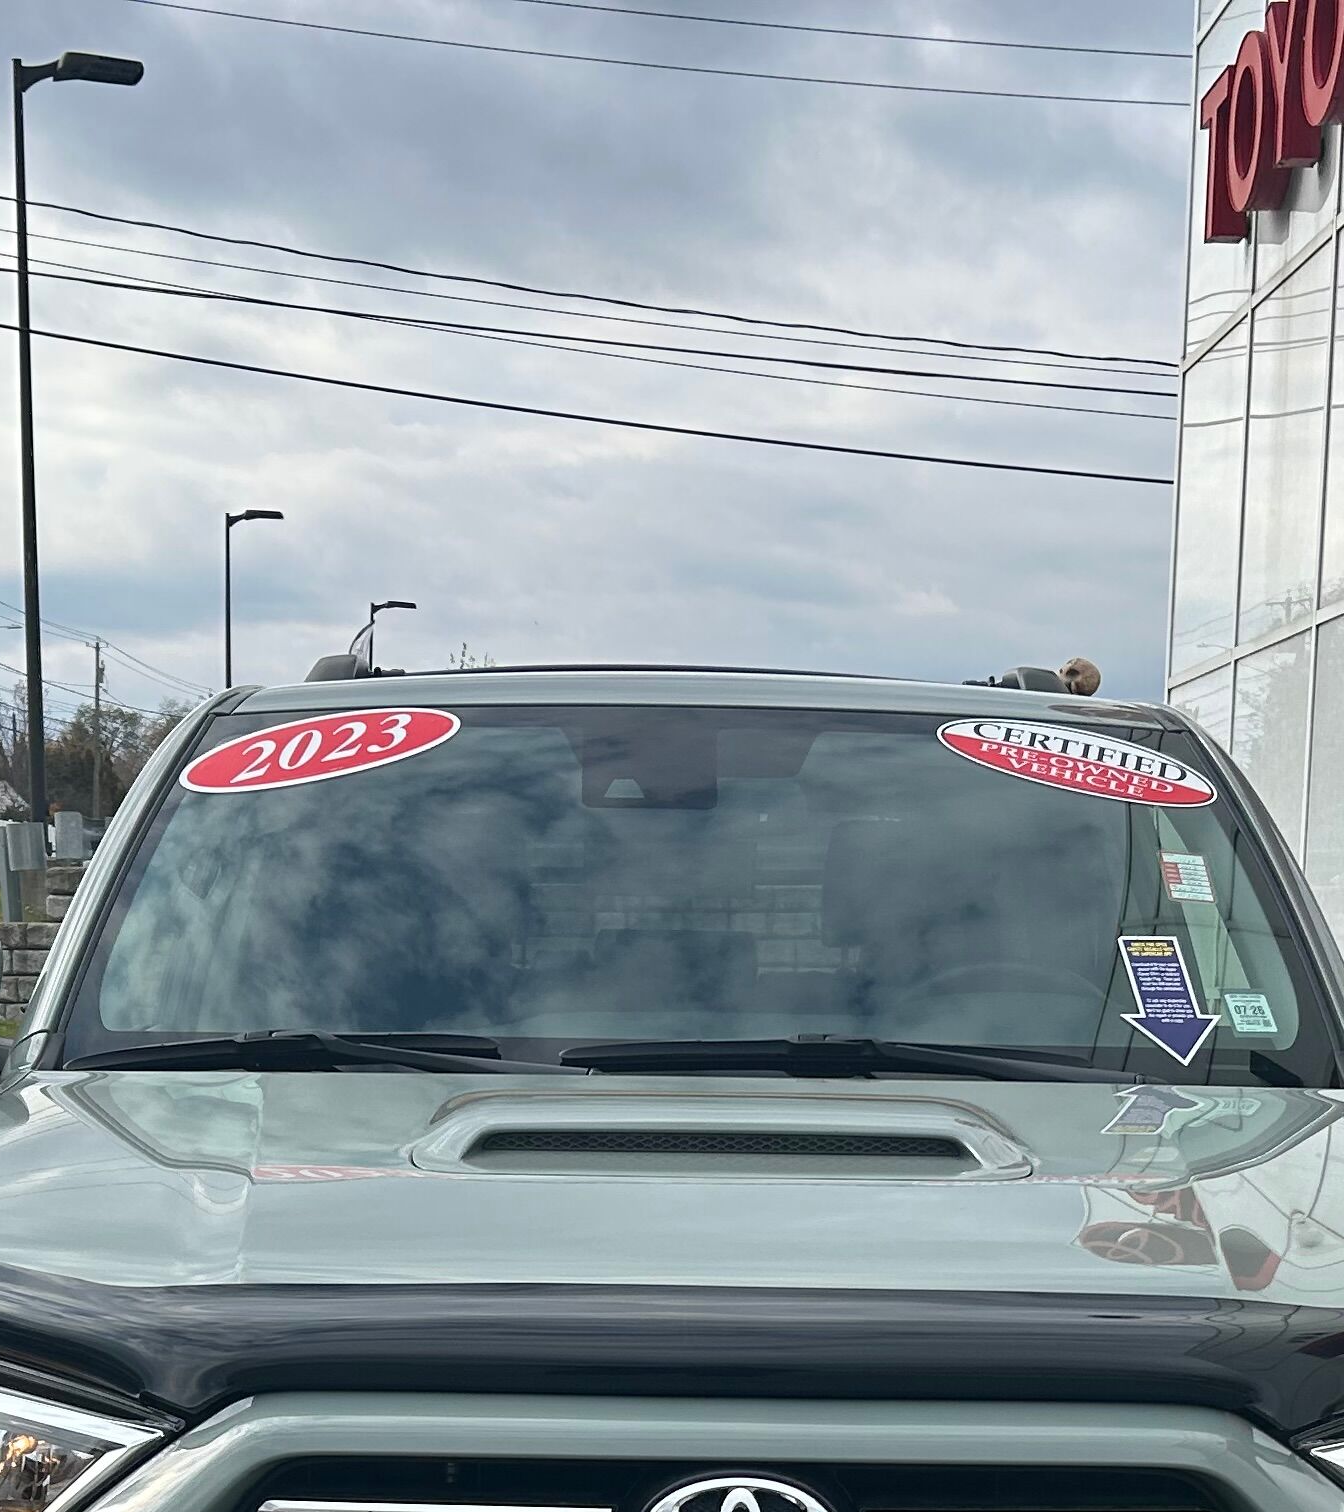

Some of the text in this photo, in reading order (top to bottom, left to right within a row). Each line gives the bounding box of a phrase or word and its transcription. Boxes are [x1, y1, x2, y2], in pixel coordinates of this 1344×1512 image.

[229, 713, 413, 784] 2023
[973, 723, 1187, 782] CERTIFIED
[980, 742, 1174, 793] PRE-OWNED
[1008, 758, 1145, 798] VEHICLE
